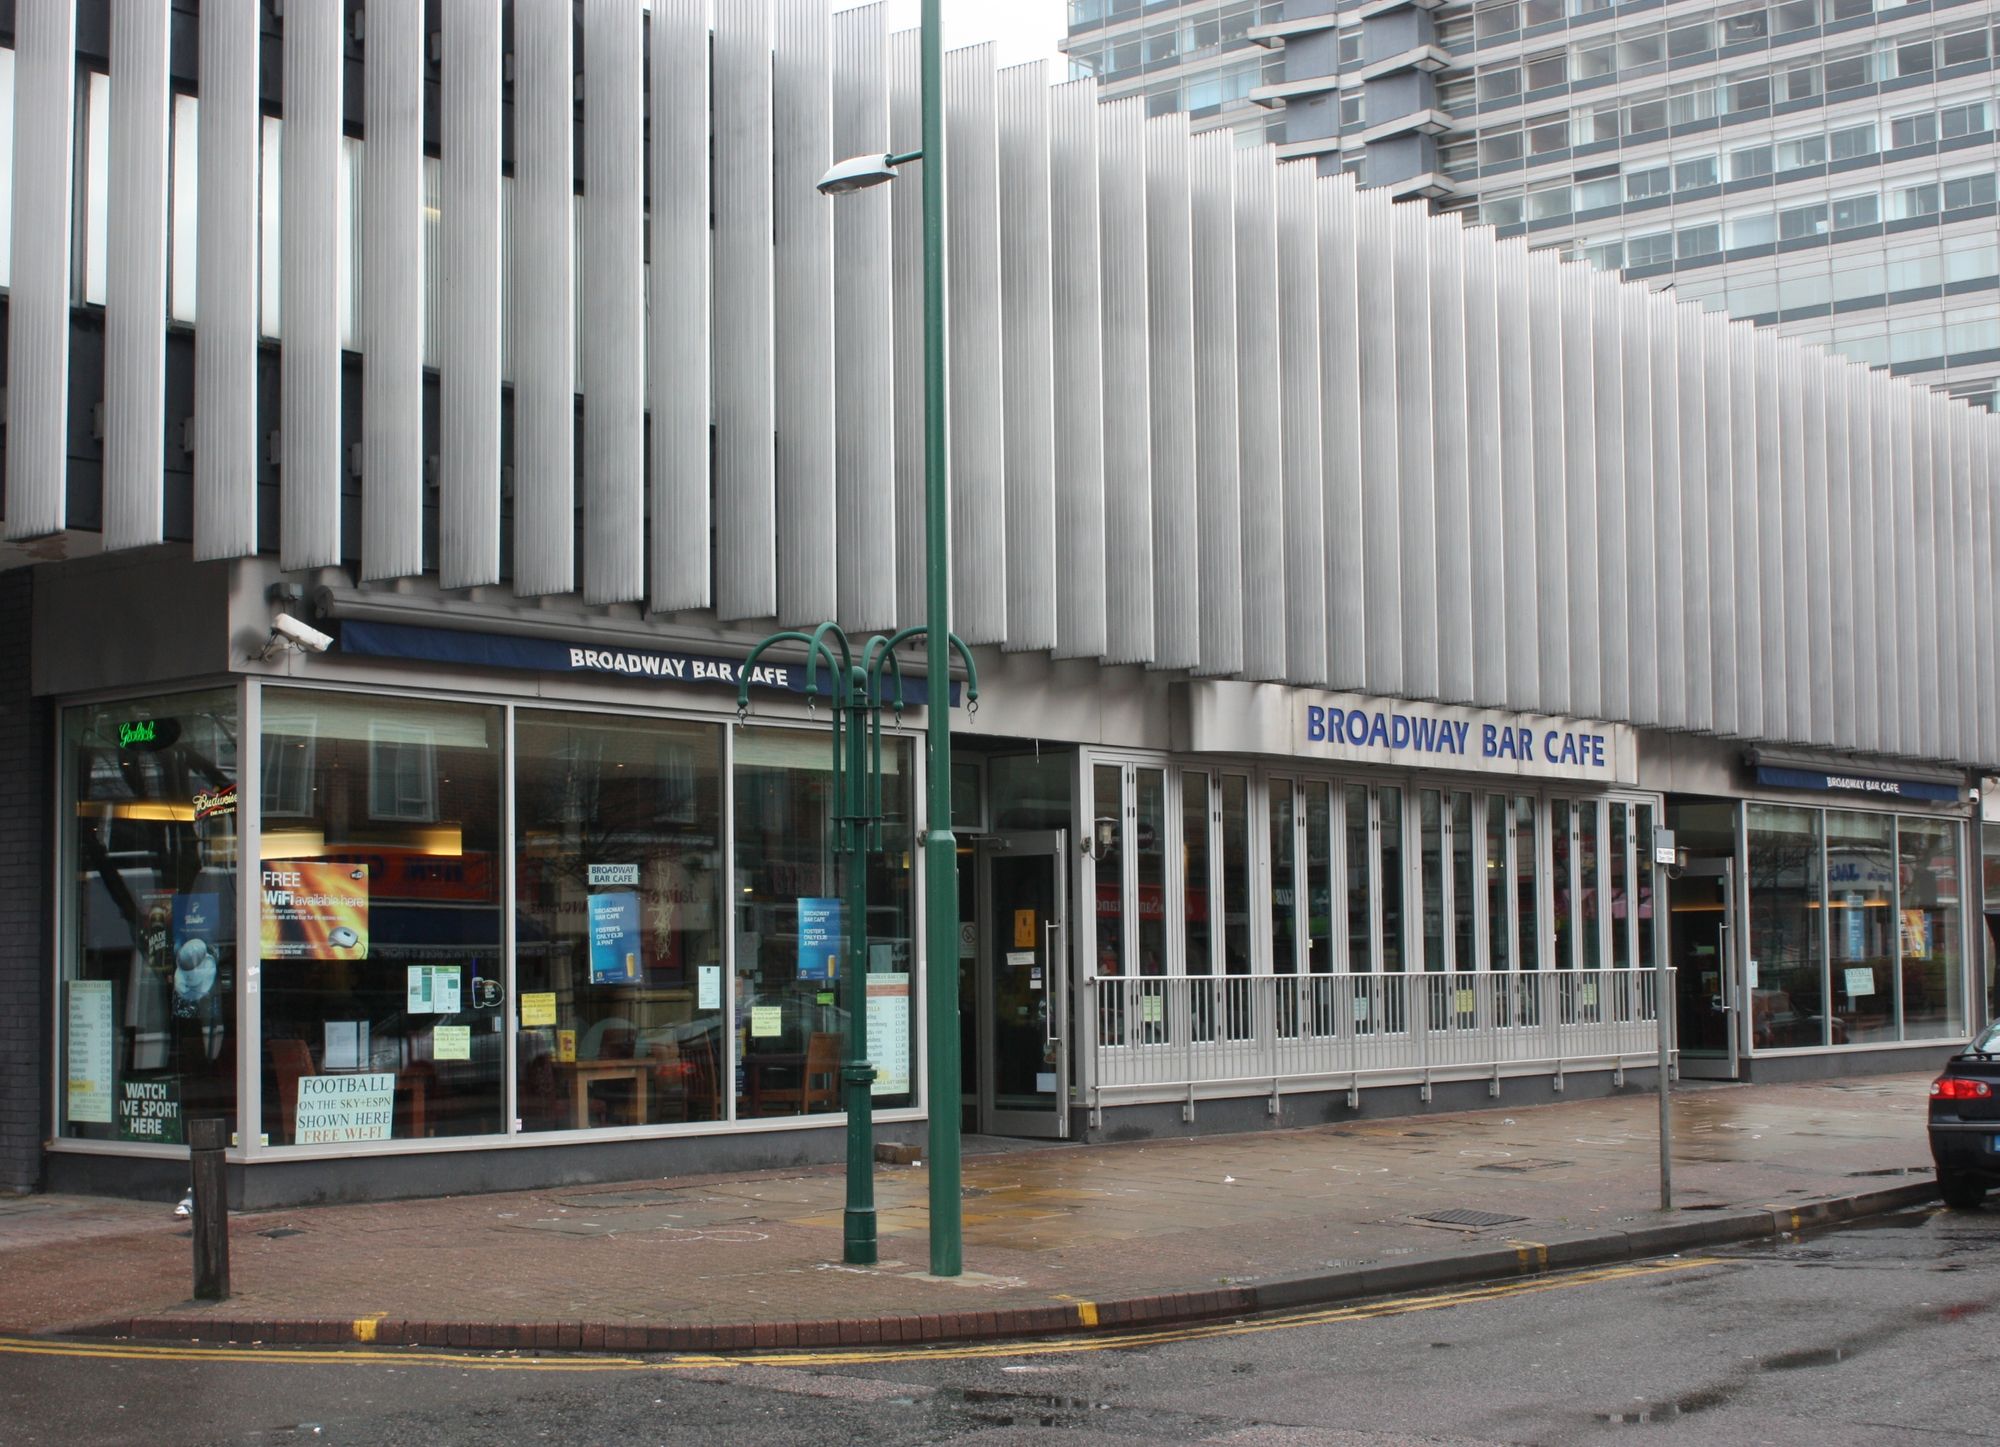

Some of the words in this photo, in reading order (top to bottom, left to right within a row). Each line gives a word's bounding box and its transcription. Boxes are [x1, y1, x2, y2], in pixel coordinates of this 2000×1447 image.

[569, 648, 686, 678] BROADWAY
[692, 660, 734, 682] BAR
[738, 663, 788, 686] CAFE
[1307, 705, 1470, 755] BROADWAY
[1482, 724, 1534, 761] BAR
[1544, 730, 1605, 767] CAFE
[1826, 776, 1865, 790] BROADWAY
[1865, 780, 1881, 791] BAR
[1881, 782, 1900, 794] CAFE
[591, 866, 635, 874] BROADWAY
[262, 871, 301, 887] FREE
[263, 890, 294, 906] WiFi
[295, 893, 339, 906] available
[340, 895, 365, 907] here
[125, 1083, 167, 1100] WATCH
[303, 1076, 389, 1094] FOOTBALL
[120, 1100, 138, 1116] IVE
[141, 1102, 178, 1118] SPORT
[299, 1101, 314, 1111] ON
[317, 1100, 337, 1110] THE
[340, 1096, 391, 1109] SKY+ESPN
[130, 1119, 162, 1135] HERE
[298, 1113, 350, 1129] SHOWN
[355, 1111, 391, 1125] HERE
[304, 1129, 340, 1143] FREE
[345, 1126, 383, 1140] WI-FI
